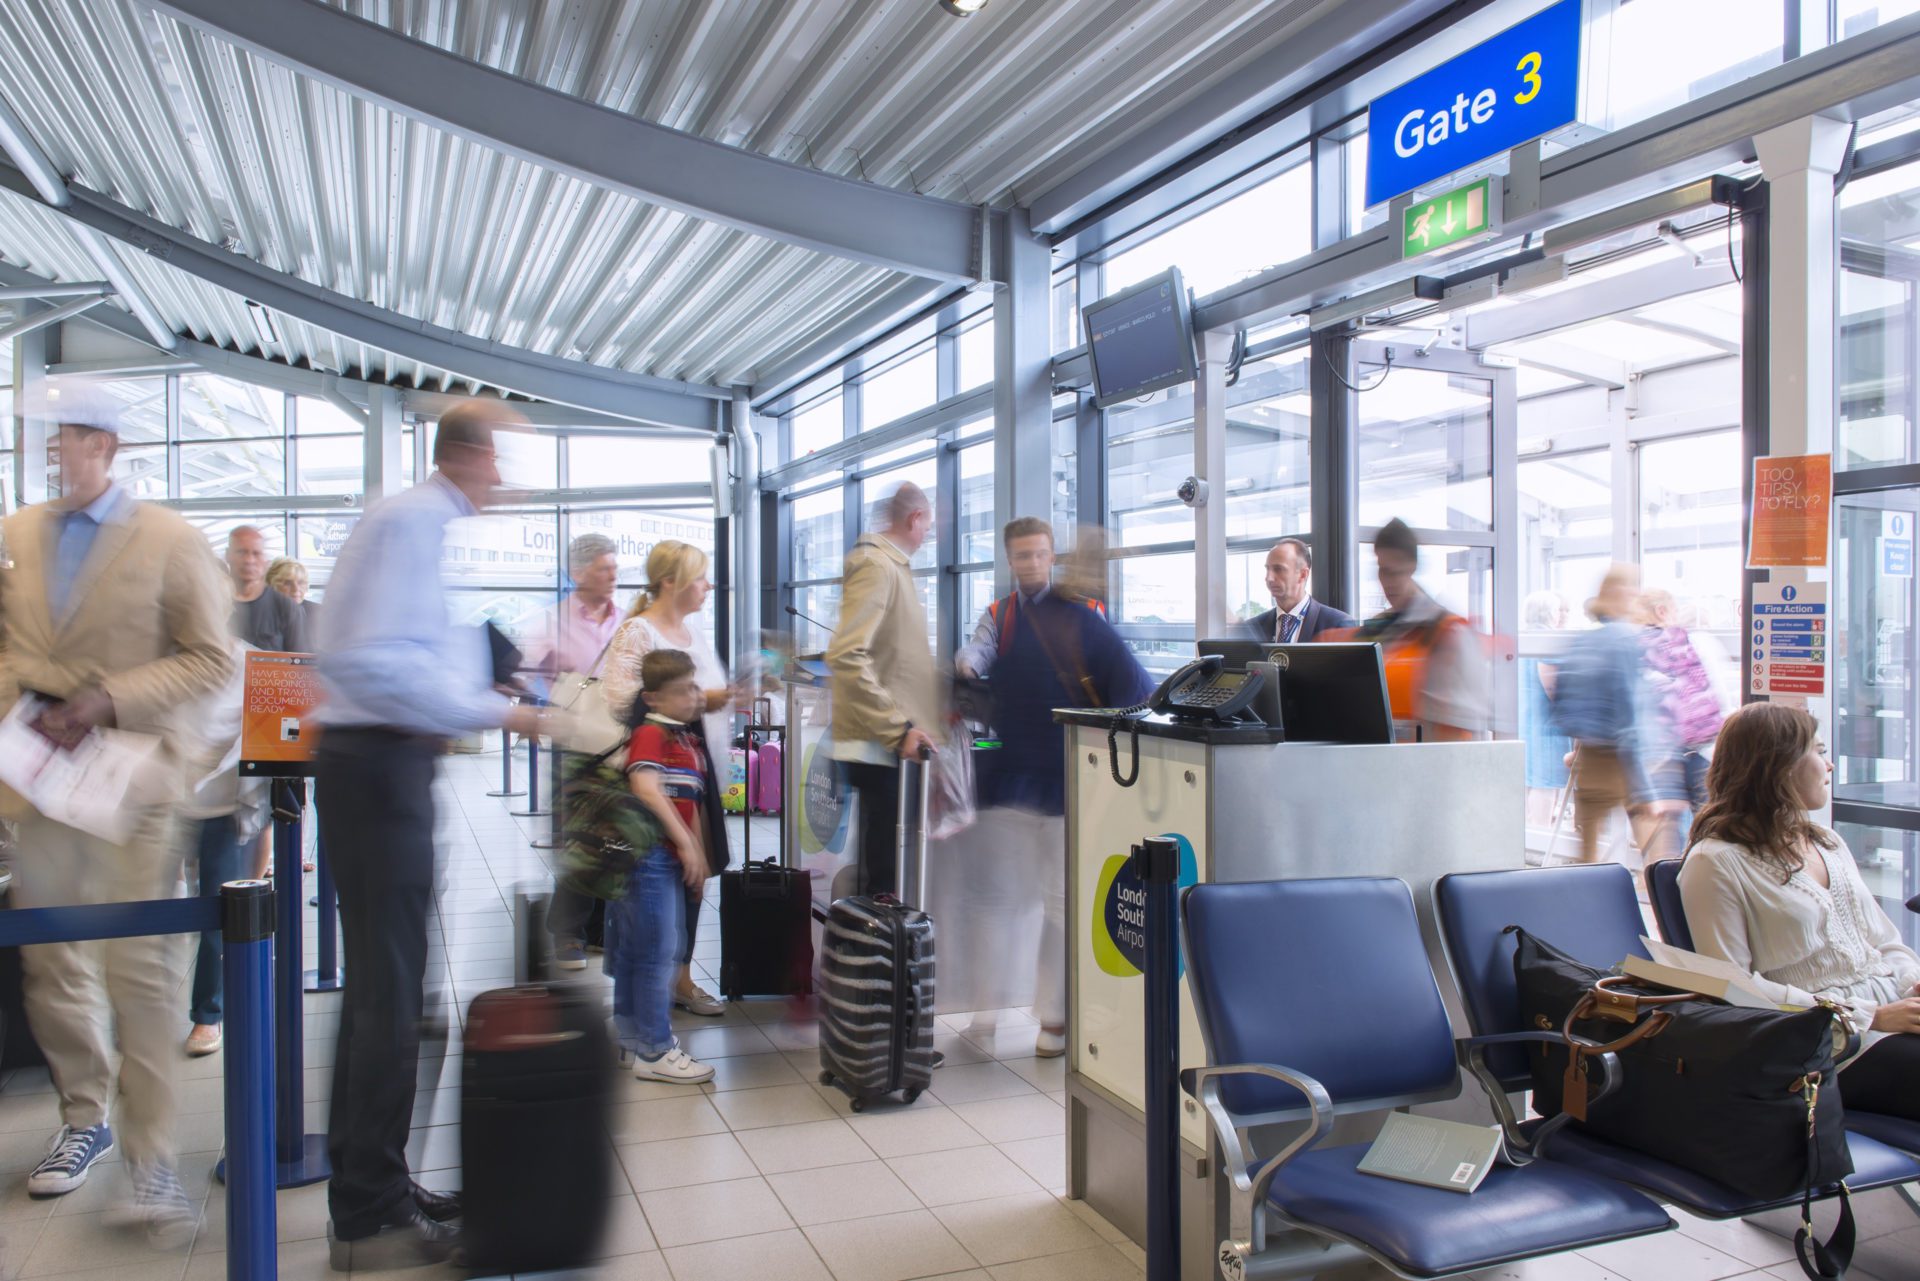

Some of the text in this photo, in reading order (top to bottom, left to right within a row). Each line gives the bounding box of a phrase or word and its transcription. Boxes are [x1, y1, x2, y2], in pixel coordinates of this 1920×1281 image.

[1394, 51, 1542, 158] Gate 3
[1760, 467, 1794, 481] TOO
[1760, 481, 1802, 496] TIPSY
[1760, 494, 1820, 510] TO FLY?
[1764, 605, 1813, 613] Fire Action
[252, 670, 312, 680] HAVE YOUR
[252, 679, 306, 688] BOARDING
[251, 688, 315, 697] AND TRAVEL
[251, 696, 317, 705] DOCUMENTS
[250, 705, 285, 713] READY
[811, 769, 832, 790] London
[1117, 882, 1145, 907] Lond
[1117, 903, 1145, 928] South
[1117, 923, 1145, 949] Airpo
